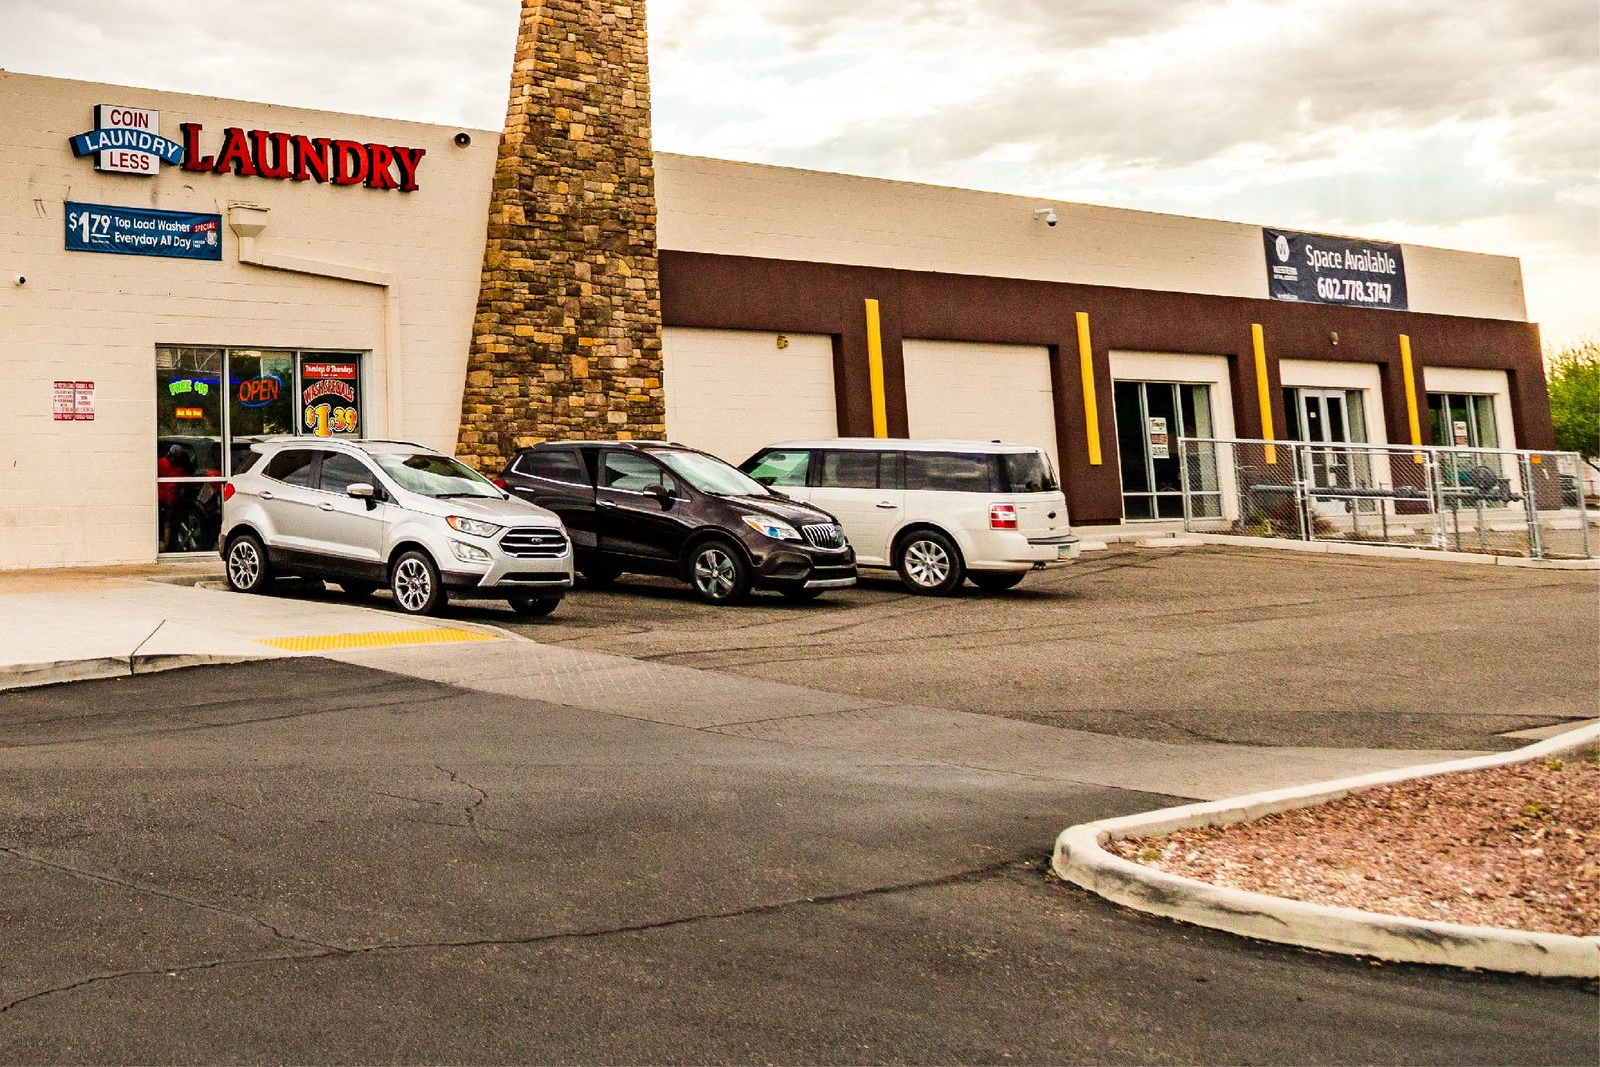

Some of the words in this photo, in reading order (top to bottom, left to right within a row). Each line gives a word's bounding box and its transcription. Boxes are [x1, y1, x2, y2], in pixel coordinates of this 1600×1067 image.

[111, 109, 149, 128] COIN
[84, 131, 179, 159] LAUNDRY
[109, 151, 149, 171] LESS
[180, 123, 426, 192] LAUNDRY
[115, 217, 131, 230] Top
[133, 218, 155, 230] Load
[157, 220, 190, 232] Washer
[115, 232, 158, 247] Everyday
[160, 235, 171, 246] All
[174, 236, 191, 249] Day
[1305, 244, 1342, 272] Space
[1344, 249, 1396, 274] Available
[1317, 277, 1392, 303] 602.778.3747
[239, 379, 279, 402] OPEN
[304, 403, 358, 438] $1.39
